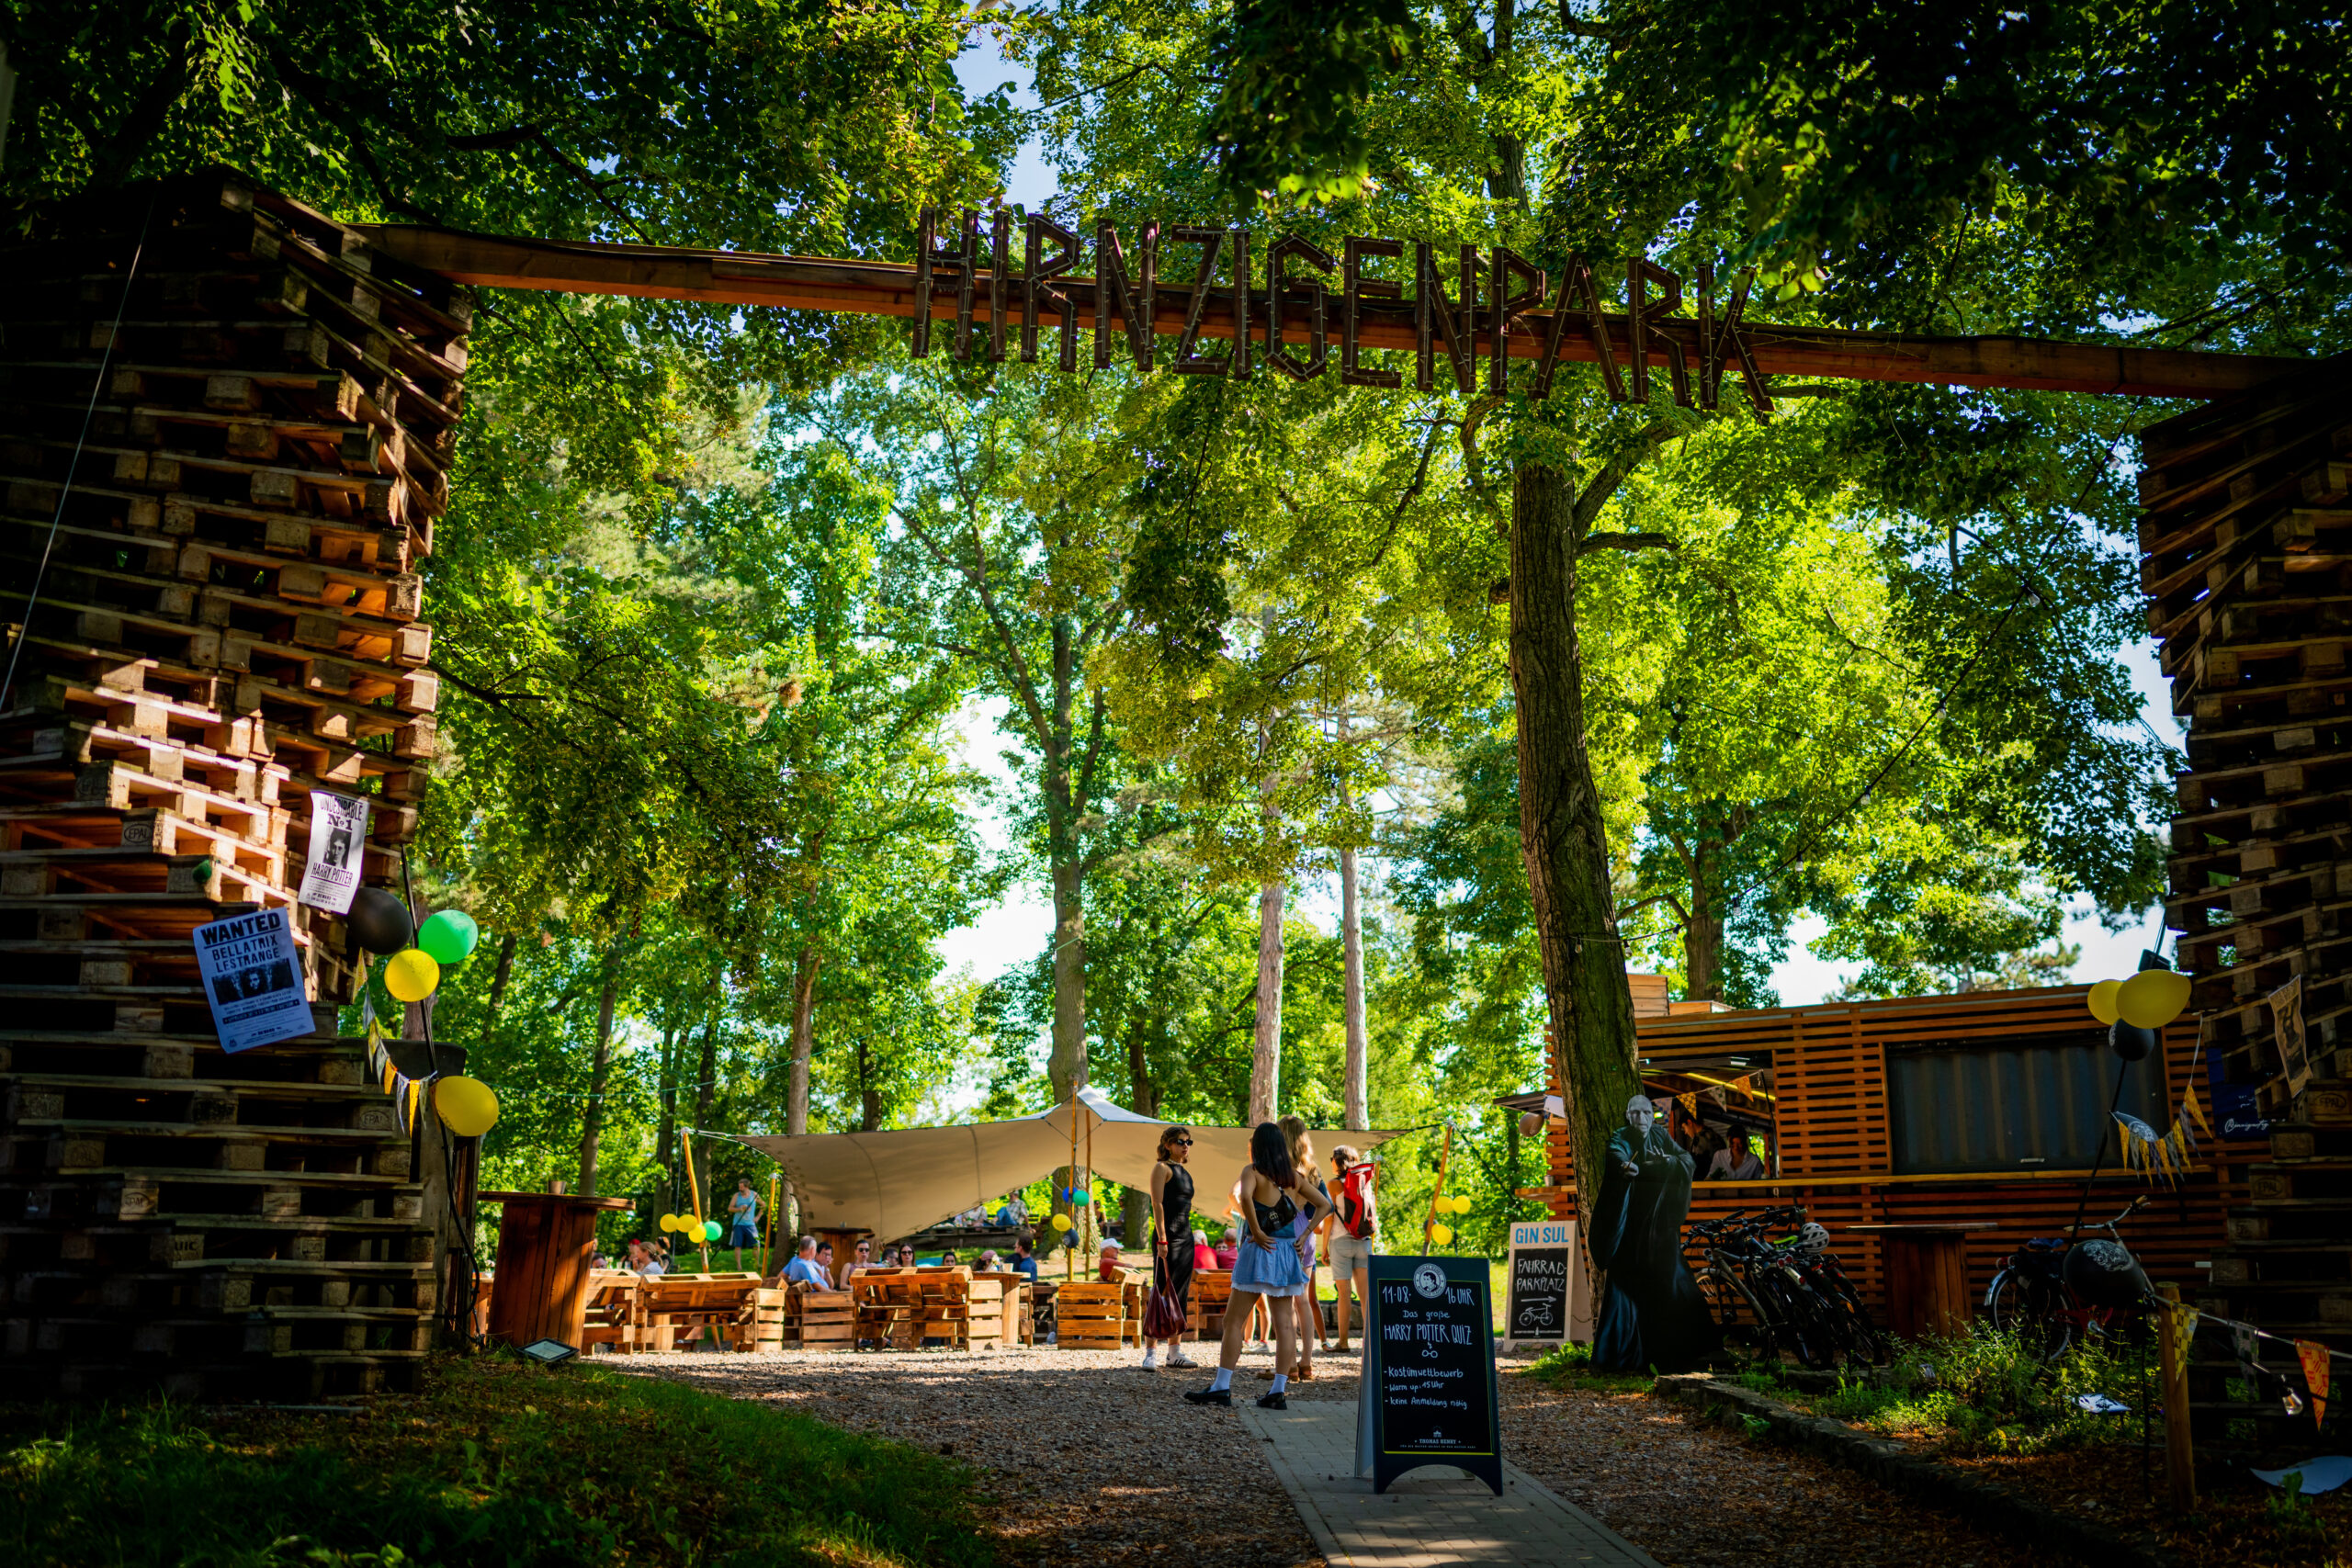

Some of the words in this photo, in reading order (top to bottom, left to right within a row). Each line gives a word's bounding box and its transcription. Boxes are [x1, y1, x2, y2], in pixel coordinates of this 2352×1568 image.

[913, 207, 1775, 412] HIRNZIGENPARK
[320, 795, 363, 822] UNDESIRABLE
[311, 862, 332, 879] HARRY
[332, 867, 353, 886] POTTER
[200, 912, 280, 946] WANTED
[212, 934, 278, 961] BELLATRIX
[216, 947, 280, 973] LESTRANGE
[1515, 1227, 1539, 1244] GIN
[1543, 1226, 1568, 1243] SUL
[1516, 1276, 1566, 1292] PARKPLATZ
[1445, 1287, 1456, 1304] 16
[1456, 1288, 1476, 1306] UHR
[1402, 1310, 1419, 1318] Das
[1425, 1310, 1452, 1321] große
[1384, 1324, 1412, 1341] HARRY
[1416, 1324, 1451, 1343] POTTER
[1421, 1381, 1430, 1389] 15
[1430, 1381, 1445, 1389] Uhr
[1390, 1396, 1408, 1405] keine
[1411, 1396, 1447, 1408] Anmeldung
